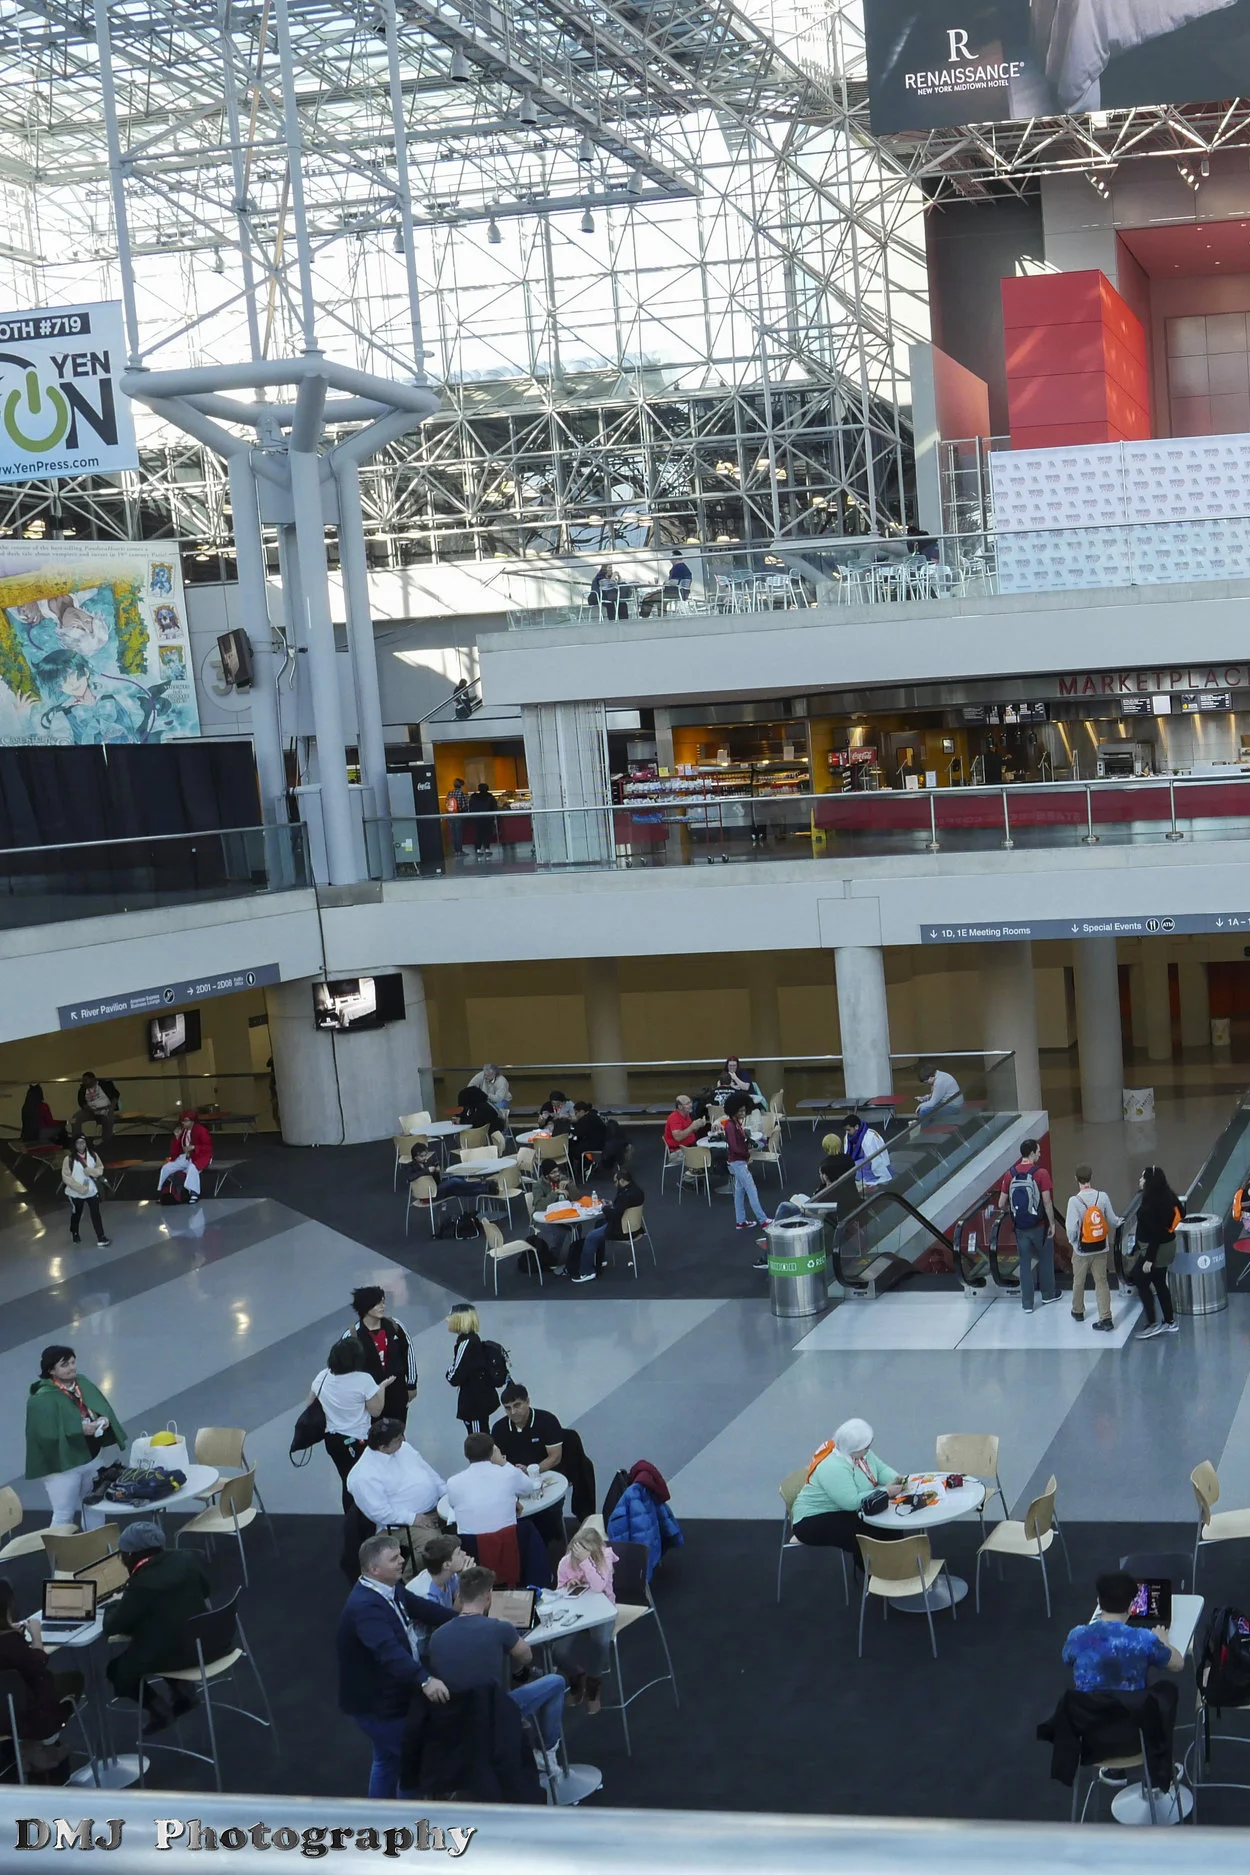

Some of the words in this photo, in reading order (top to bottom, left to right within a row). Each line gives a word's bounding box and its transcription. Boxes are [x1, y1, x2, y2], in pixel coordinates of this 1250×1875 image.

[946, 28, 979, 62] R
[905, 62, 1021, 89] RENAISSANCE
[934, 85, 952, 94] YORK
[954, 82, 987, 91] MIDTOWN
[988, 79, 1009, 87] HOTEL
[39, 316, 82, 336] #719
[50, 350, 111, 379] YEN
[0, 457, 99, 475] w.YenPress.com
[1083, 924, 1112, 933] Special
[1114, 922, 1142, 930] Events
[1228, 918, 1239, 926] 1A
[942, 930, 955, 938] 1D,
[969, 928, 1001, 938] Meeting
[1003, 927, 1031, 935] Rooms
[81, 1008, 99, 1019] River
[100, 1003, 127, 1014] Pavilion
